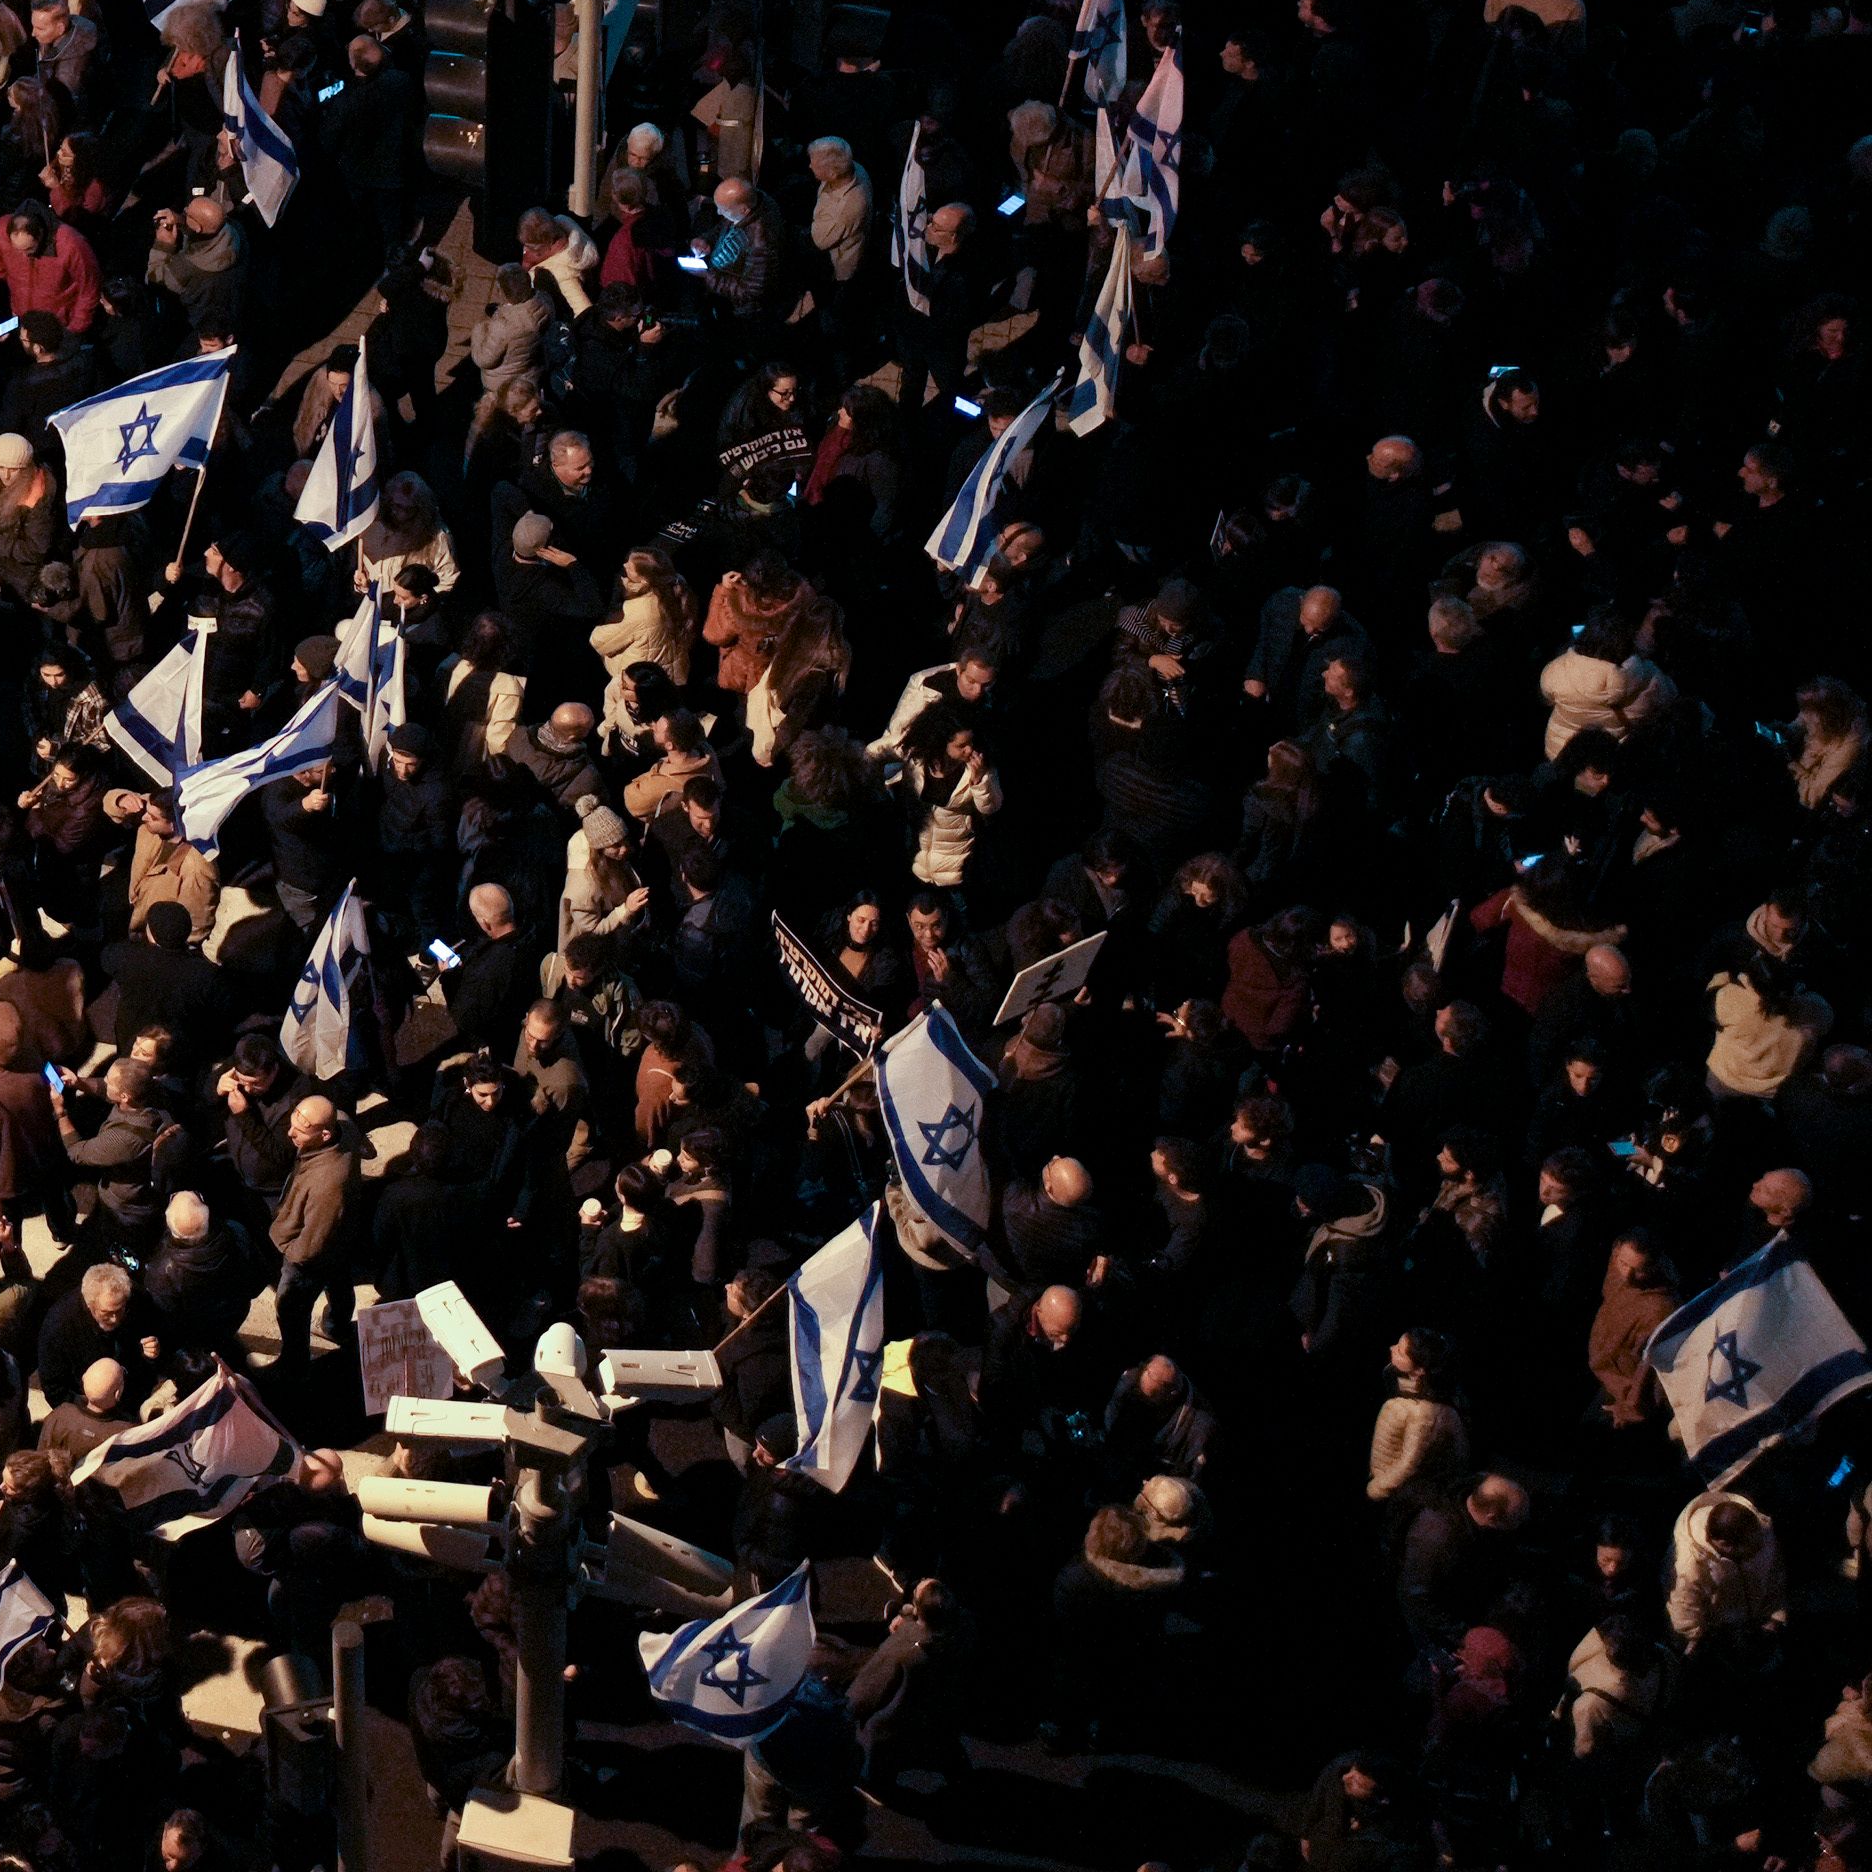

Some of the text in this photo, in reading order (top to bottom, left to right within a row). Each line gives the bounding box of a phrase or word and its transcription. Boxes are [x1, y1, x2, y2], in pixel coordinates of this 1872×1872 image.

[719, 428, 804, 465] אין דמוקרטיה
[740, 437, 808, 471] עם כיבוש
[775, 926, 840, 1007] דמוקרטי
[780, 946, 871, 1044] אין אקדמי
